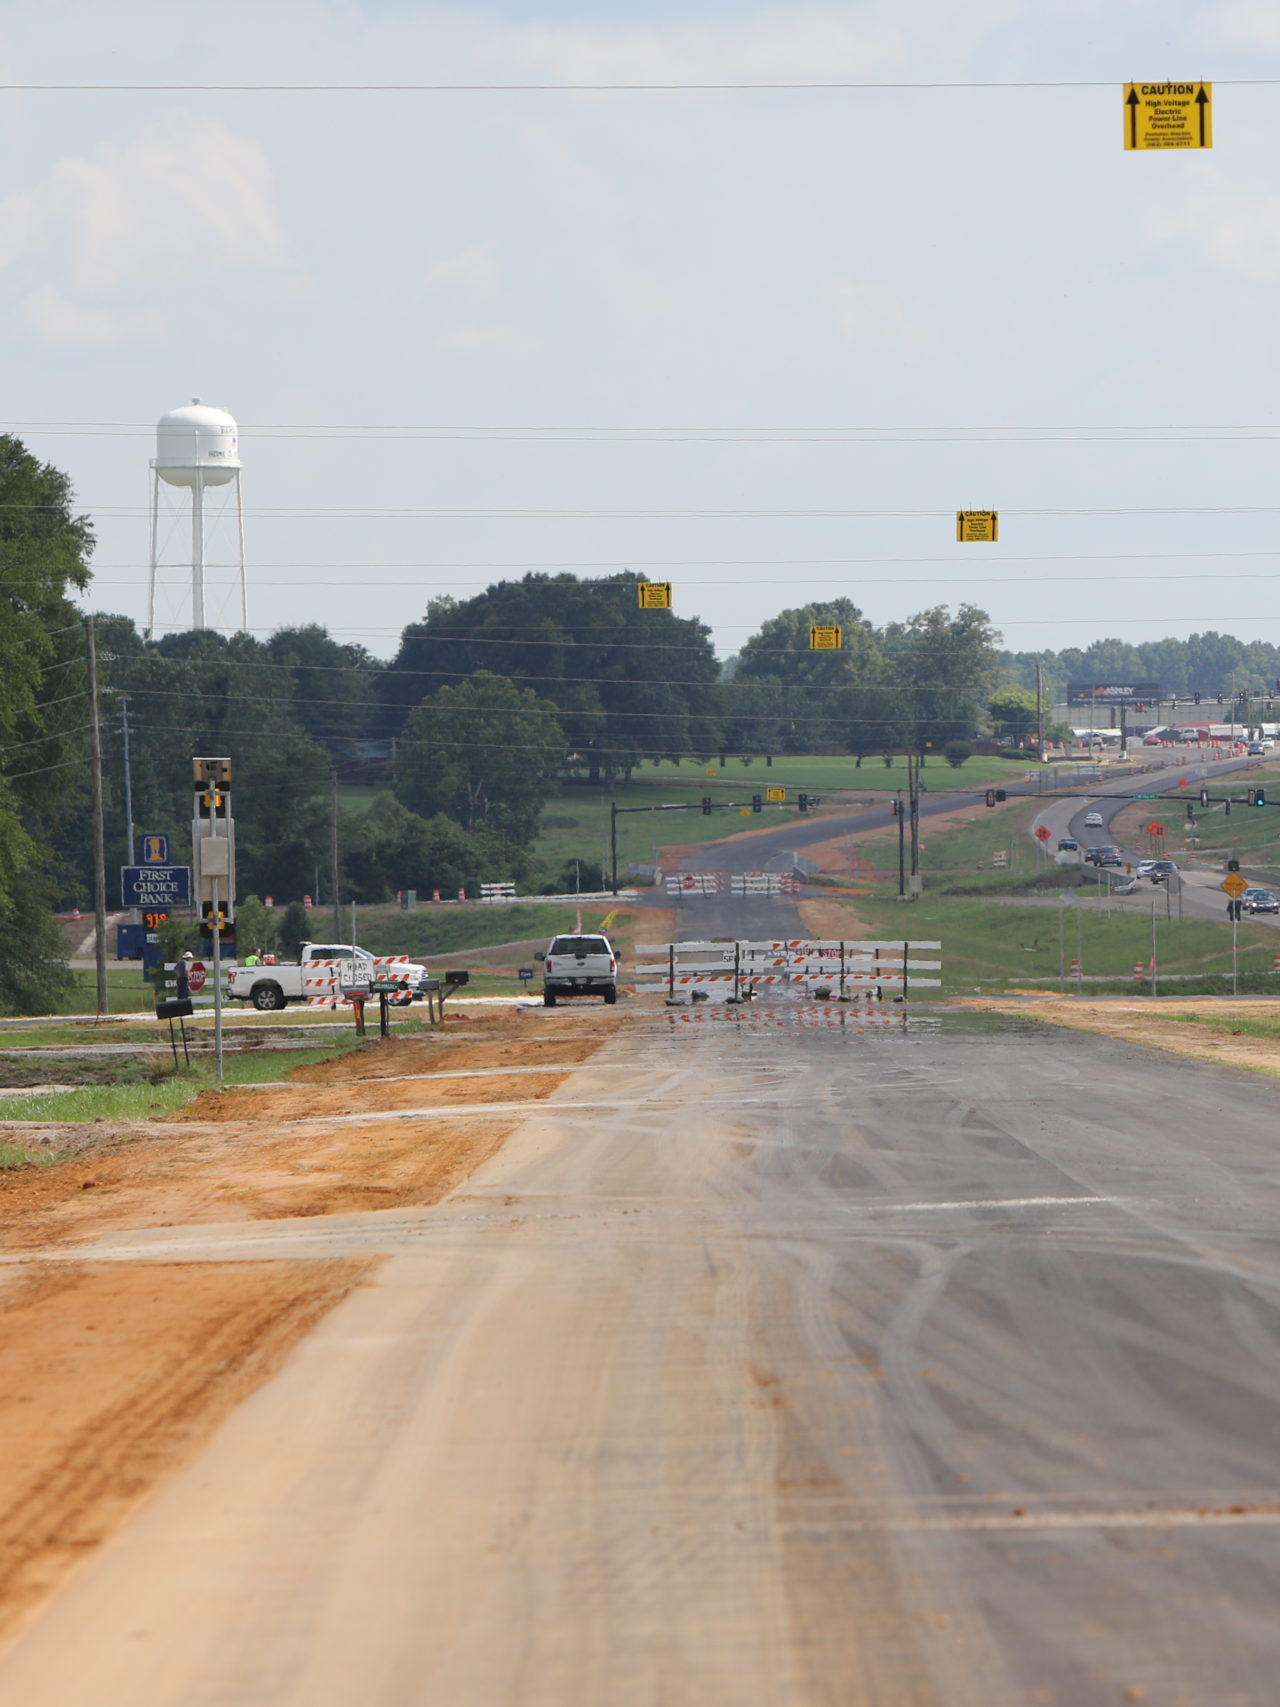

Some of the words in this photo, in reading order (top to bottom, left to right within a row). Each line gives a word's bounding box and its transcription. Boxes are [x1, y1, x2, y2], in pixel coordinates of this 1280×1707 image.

[1141, 84, 1194, 95] CAUTION
[1145, 100, 1162, 108] High
[1163, 99, 1190, 107] Voltage
[139, 870, 173, 881] FIRST
[133, 881, 178, 892] CHOICE
[140, 893, 173, 904] BANK
[347, 962, 368, 971] ROAD
[188, 971, 206, 983] STOP
